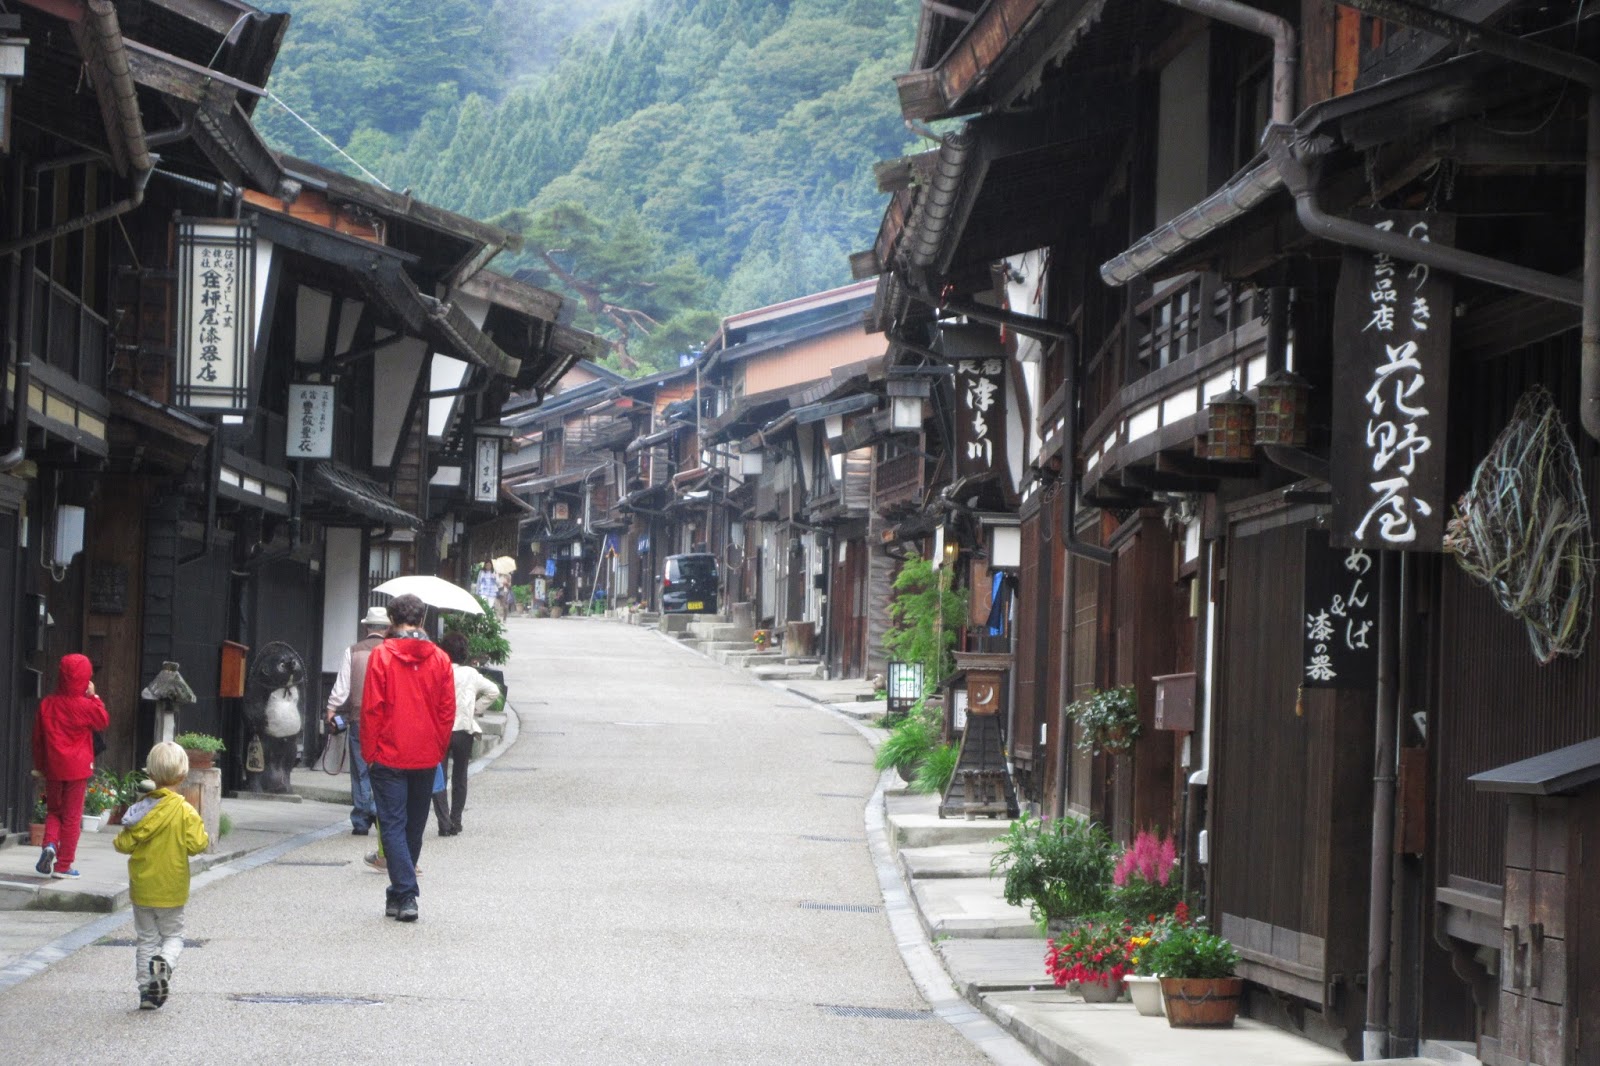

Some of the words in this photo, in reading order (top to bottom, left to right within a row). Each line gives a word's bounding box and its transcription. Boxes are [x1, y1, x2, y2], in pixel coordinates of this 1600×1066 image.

[1362, 220, 1397, 332] 芸品店
[1355, 340, 1432, 543] 花野屋
[1305, 608, 1338, 681] 漆の器
[1331, 594, 1347, 617] &
[1345, 548, 1373, 650] めんば
